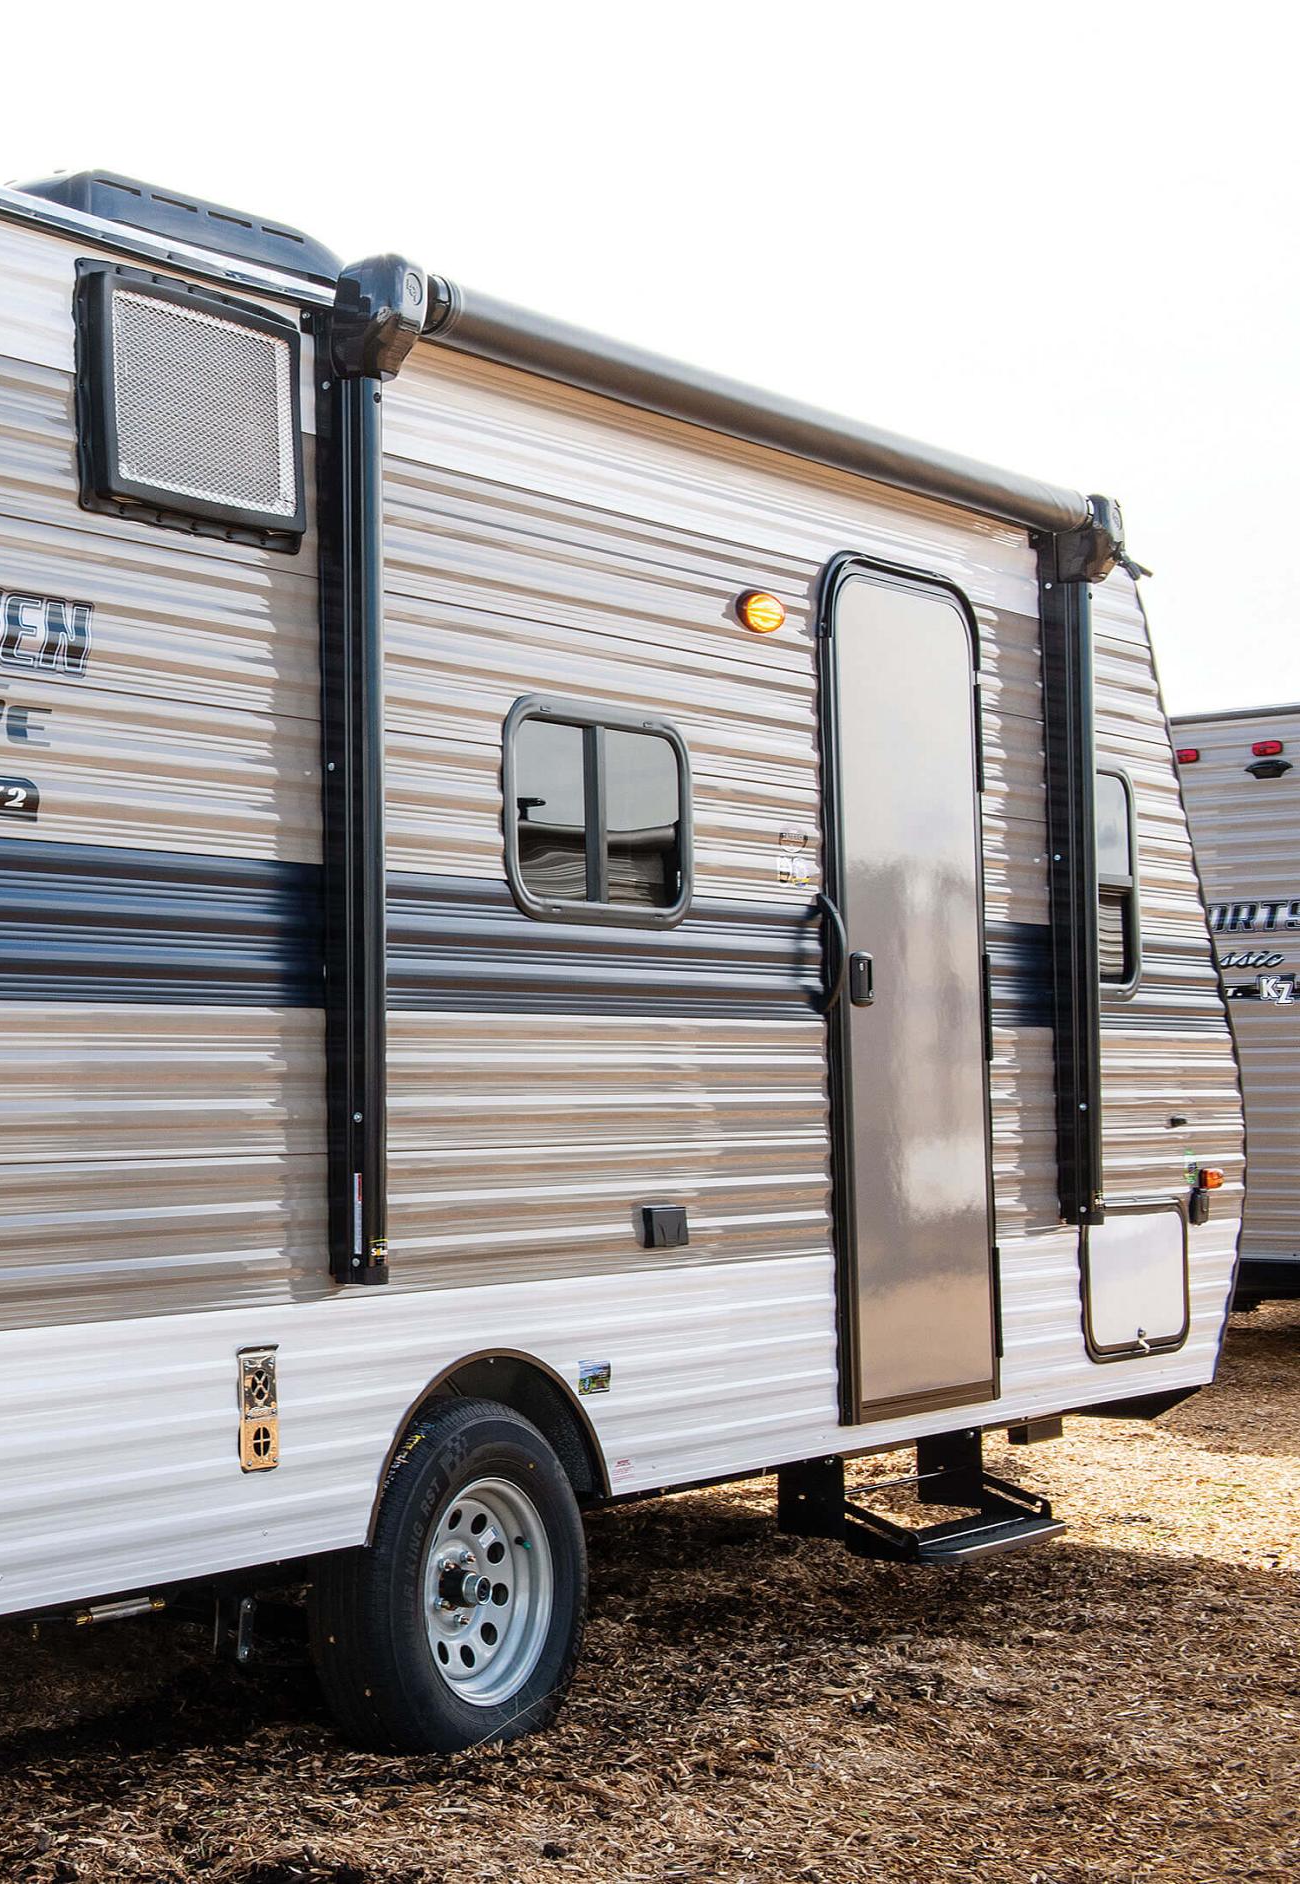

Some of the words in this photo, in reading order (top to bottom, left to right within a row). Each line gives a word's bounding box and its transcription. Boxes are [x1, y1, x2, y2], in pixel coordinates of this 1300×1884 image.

[1260, 975, 1294, 1005] KZ
[404, 1520, 424, 1577] KING
[419, 1476, 441, 1517] RST
